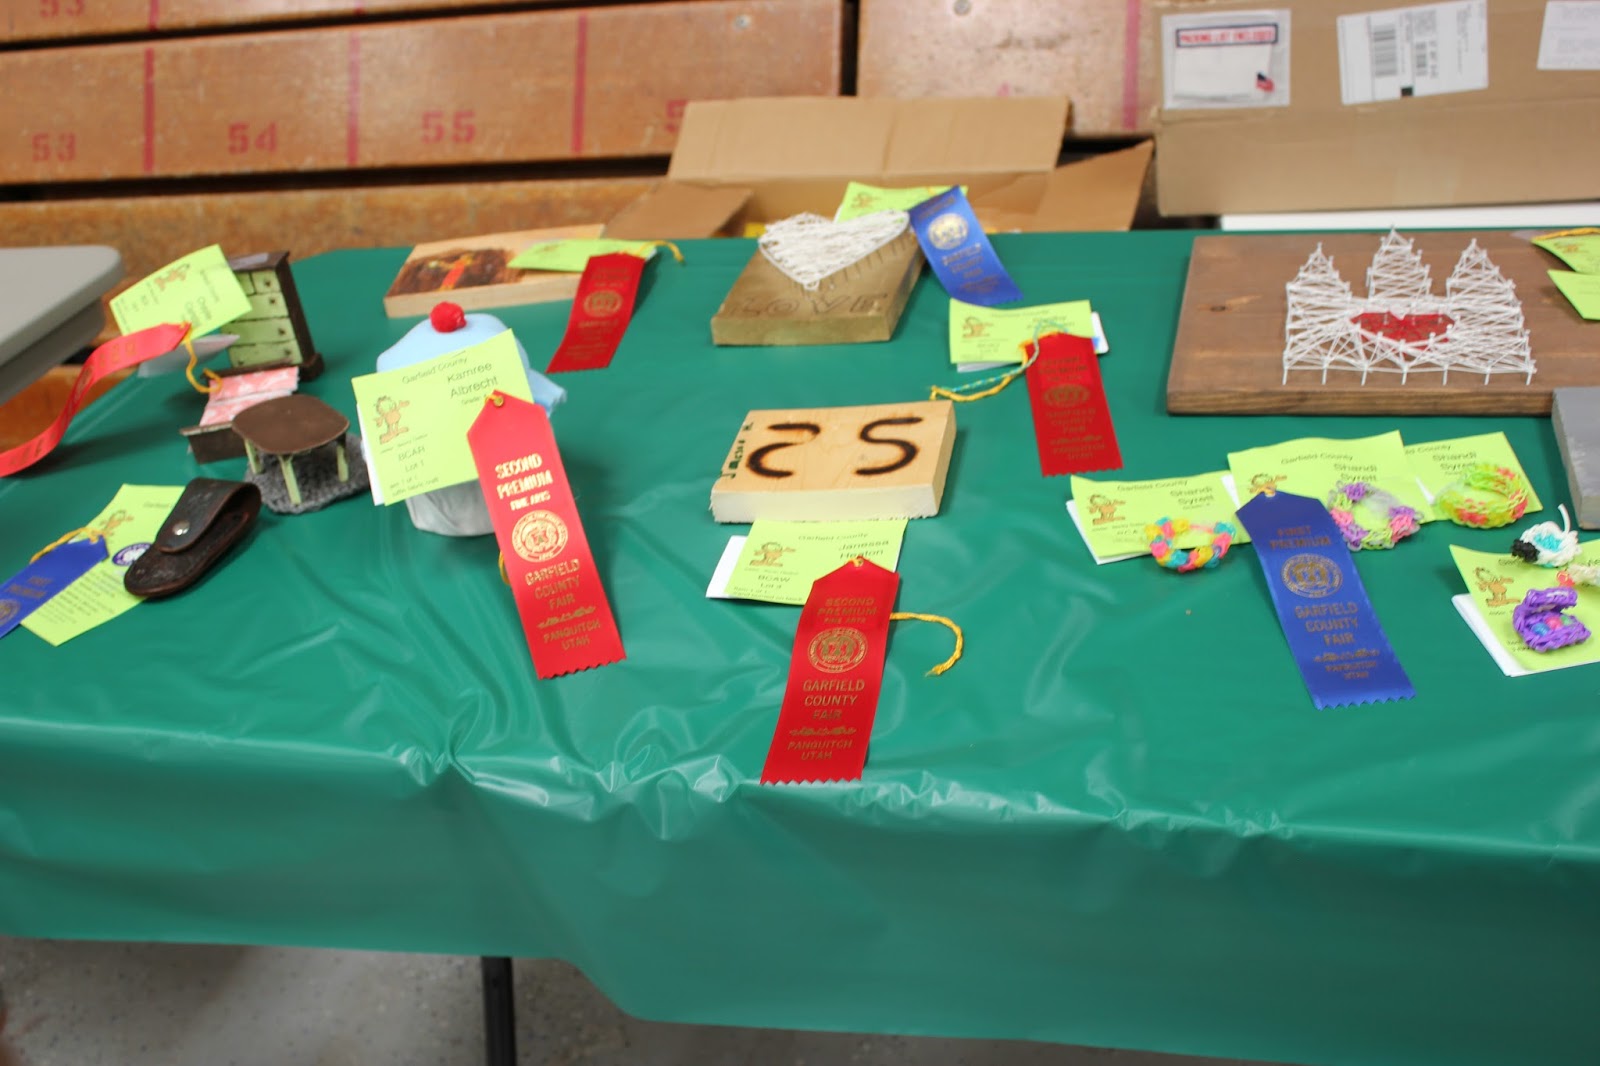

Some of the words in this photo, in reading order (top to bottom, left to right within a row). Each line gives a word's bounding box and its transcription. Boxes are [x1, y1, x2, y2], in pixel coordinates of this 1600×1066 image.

[420, 110, 477, 145] 55
[227, 123, 278, 156] 54
[33, 133, 77, 163] 53
[450, 376, 499, 399] Albrecht
[495, 452, 543, 479] SECOND
[496, 470, 554, 500] PREMIUM
[530, 491, 551, 506] ARTS
[1270, 537, 1331, 550] PREMIUM
[525, 558, 580, 586] GARFIELD
[534, 575, 580, 600] COUNTY
[549, 593, 576, 610] FAIR
[825, 597, 875, 607] SECOND
[817, 607, 877, 616] PREMIUM
[1295, 601, 1359, 619] GARFIELD
[543, 620, 601, 643] PANGUITCH
[1305, 617, 1359, 632] COUNTY
[562, 635, 590, 651] UTAH
[1323, 633, 1355, 646] FAIR
[803, 679, 865, 692] GARFIELD
[804, 695, 858, 707] COUNTY
[812, 709, 843, 720] FAIR
[787, 740, 852, 751] PANGUITCH
[800, 751, 832, 761] UTAH
